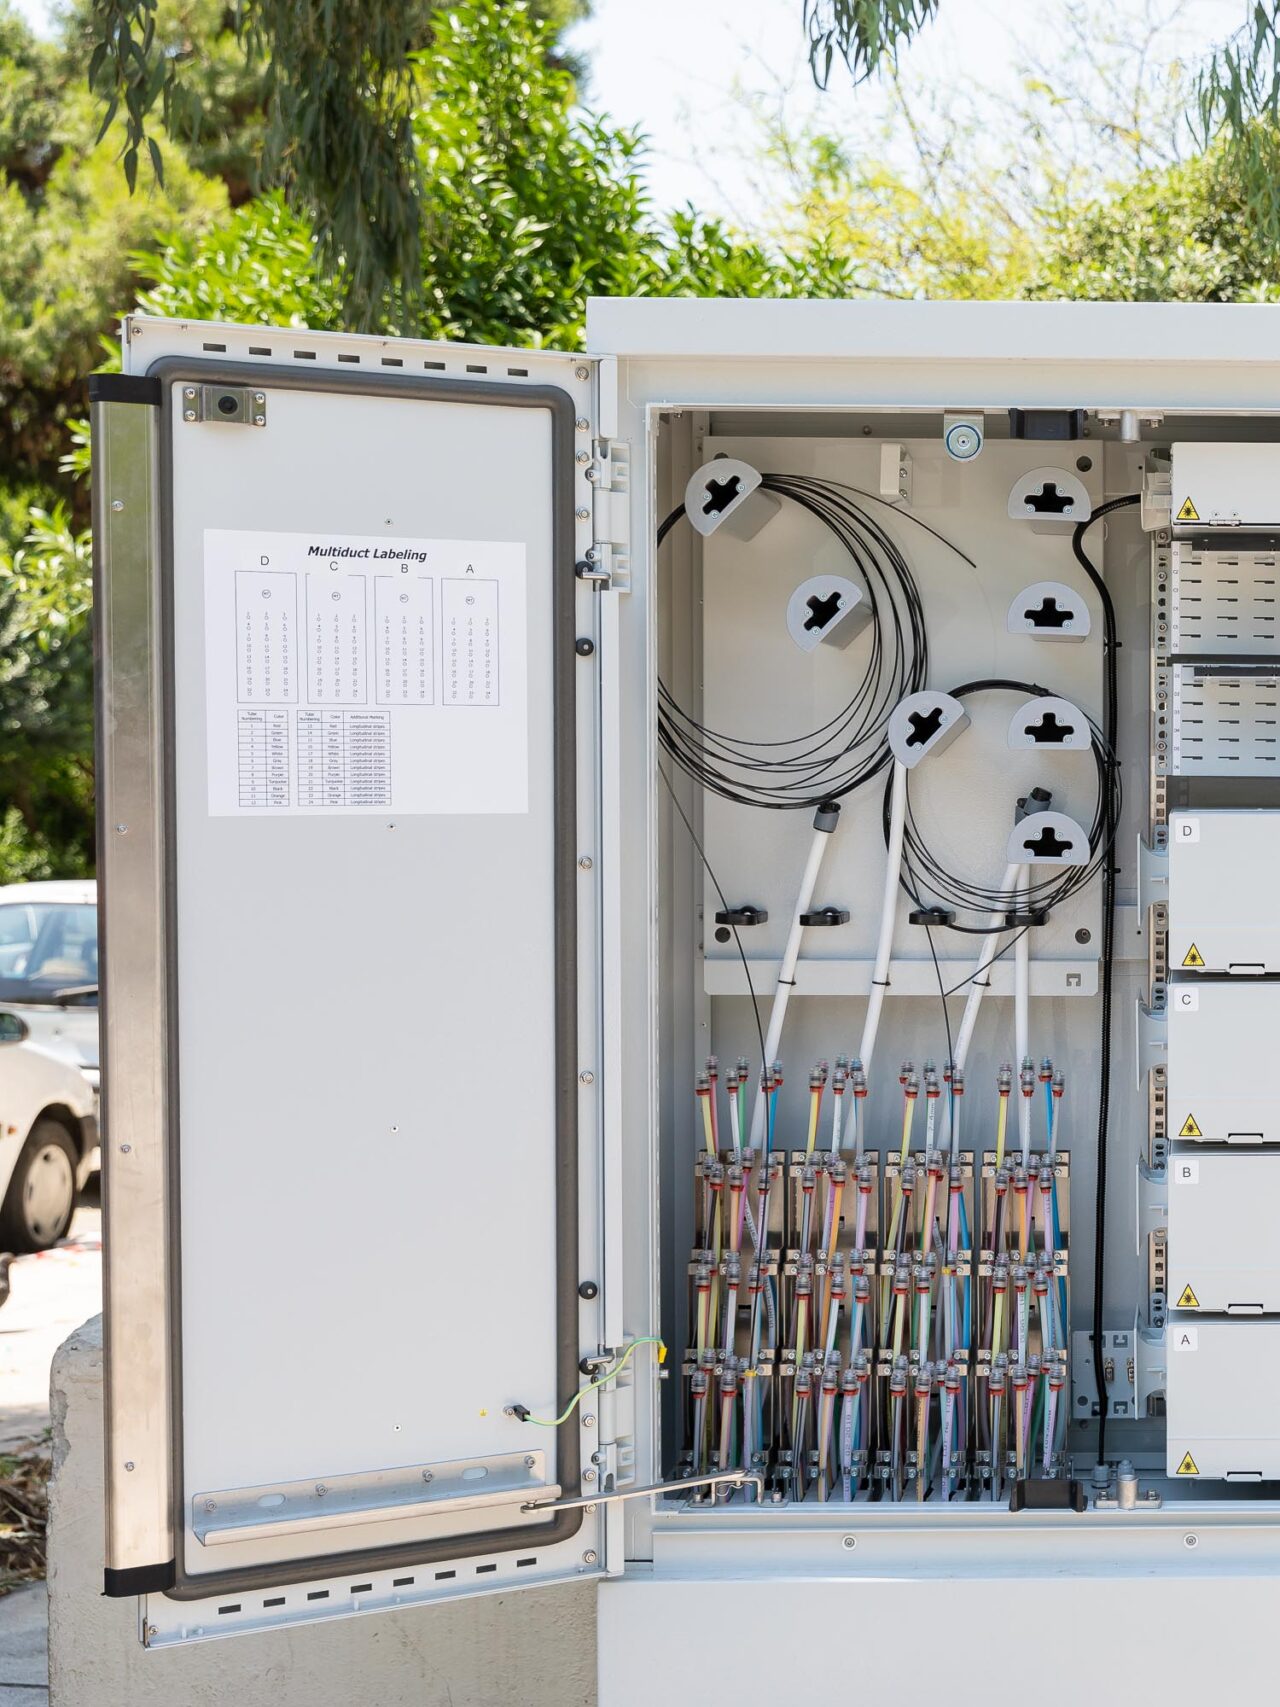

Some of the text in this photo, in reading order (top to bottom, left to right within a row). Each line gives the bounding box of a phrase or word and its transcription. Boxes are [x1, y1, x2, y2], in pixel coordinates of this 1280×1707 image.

[307, 546, 427, 563] Multiduct Labeling
[261, 556, 270, 566] D
[329, 561, 339, 571] C
[401, 564, 408, 574] B
[466, 564, 474, 574] A
[1183, 825, 1192, 837] D
[1181, 994, 1191, 1006] C
[1183, 1167, 1191, 1178] B
[1180, 1333, 1191, 1346] A
